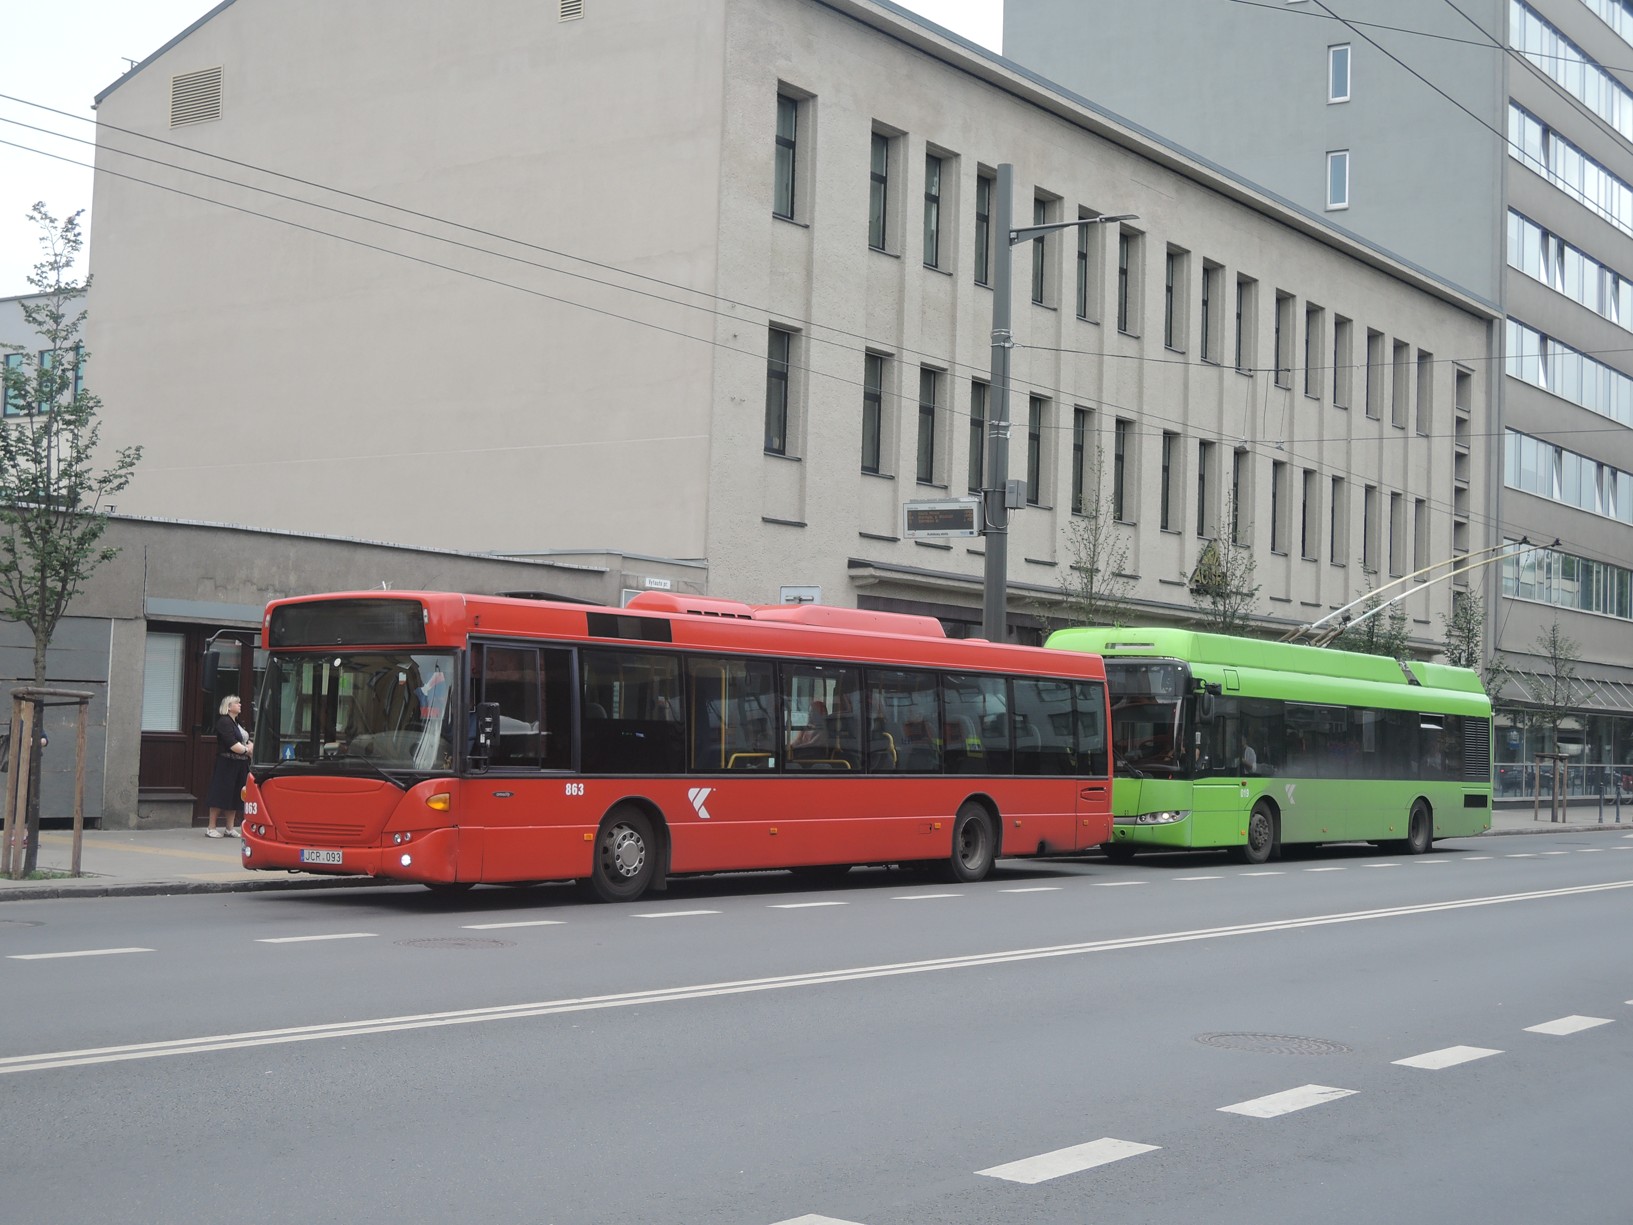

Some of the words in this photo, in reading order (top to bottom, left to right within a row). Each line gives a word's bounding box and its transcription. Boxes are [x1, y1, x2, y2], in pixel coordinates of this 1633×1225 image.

[565, 783, 584, 796] 863
[244, 802, 258, 815] 863
[305, 851, 321, 862] JCR
[326, 852, 341, 863] 093
